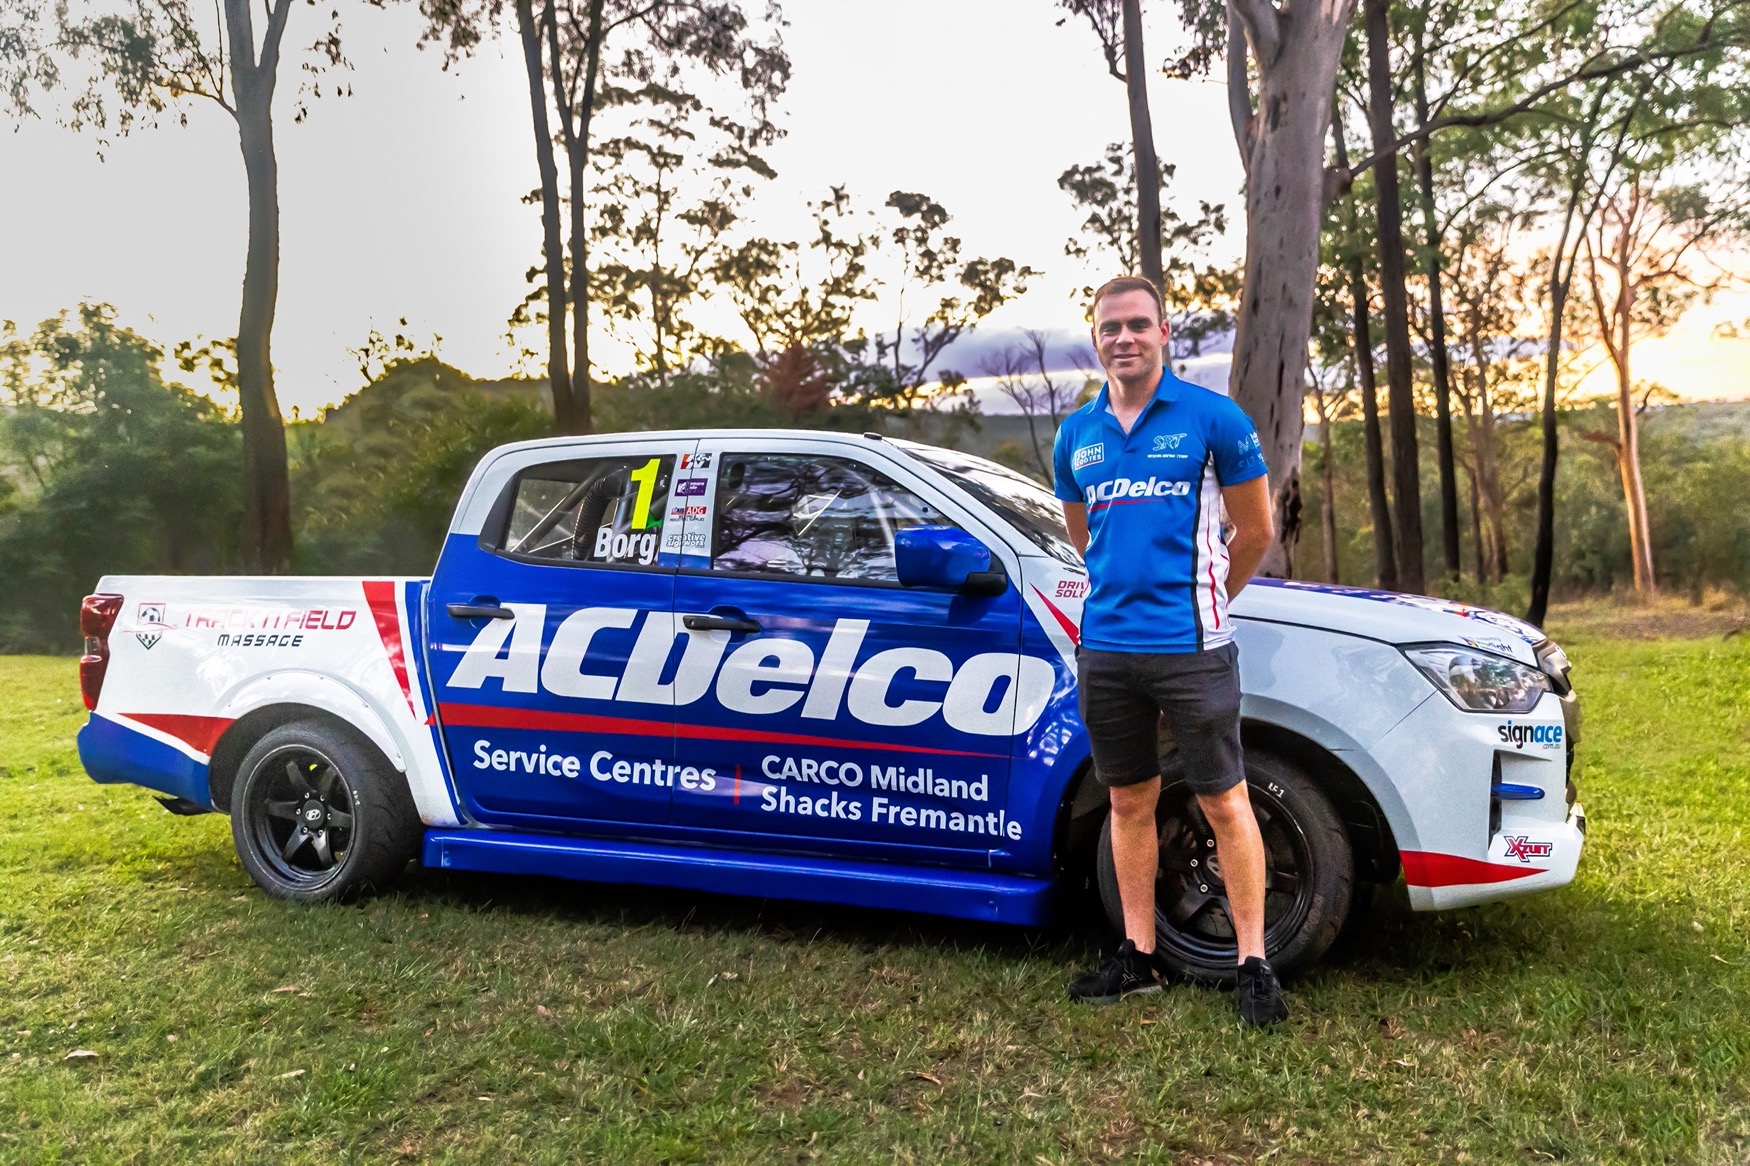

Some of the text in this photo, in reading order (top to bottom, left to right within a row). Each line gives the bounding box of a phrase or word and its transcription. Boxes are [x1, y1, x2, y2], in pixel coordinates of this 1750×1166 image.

[1076, 446, 1101, 461] JOHN
[631, 459, 660, 529] 1
[1086, 476, 1191, 504] ACDelco
[593, 527, 656, 565] Borg
[217, 634, 304, 647] MASSAGE
[446, 602, 1055, 736] ACDelco
[1497, 720, 1563, 749] signace
[473, 739, 717, 791] Service Centres
[761, 755, 989, 801] CARCO Midland
[760, 786, 1022, 840] Shacks Fremantle
